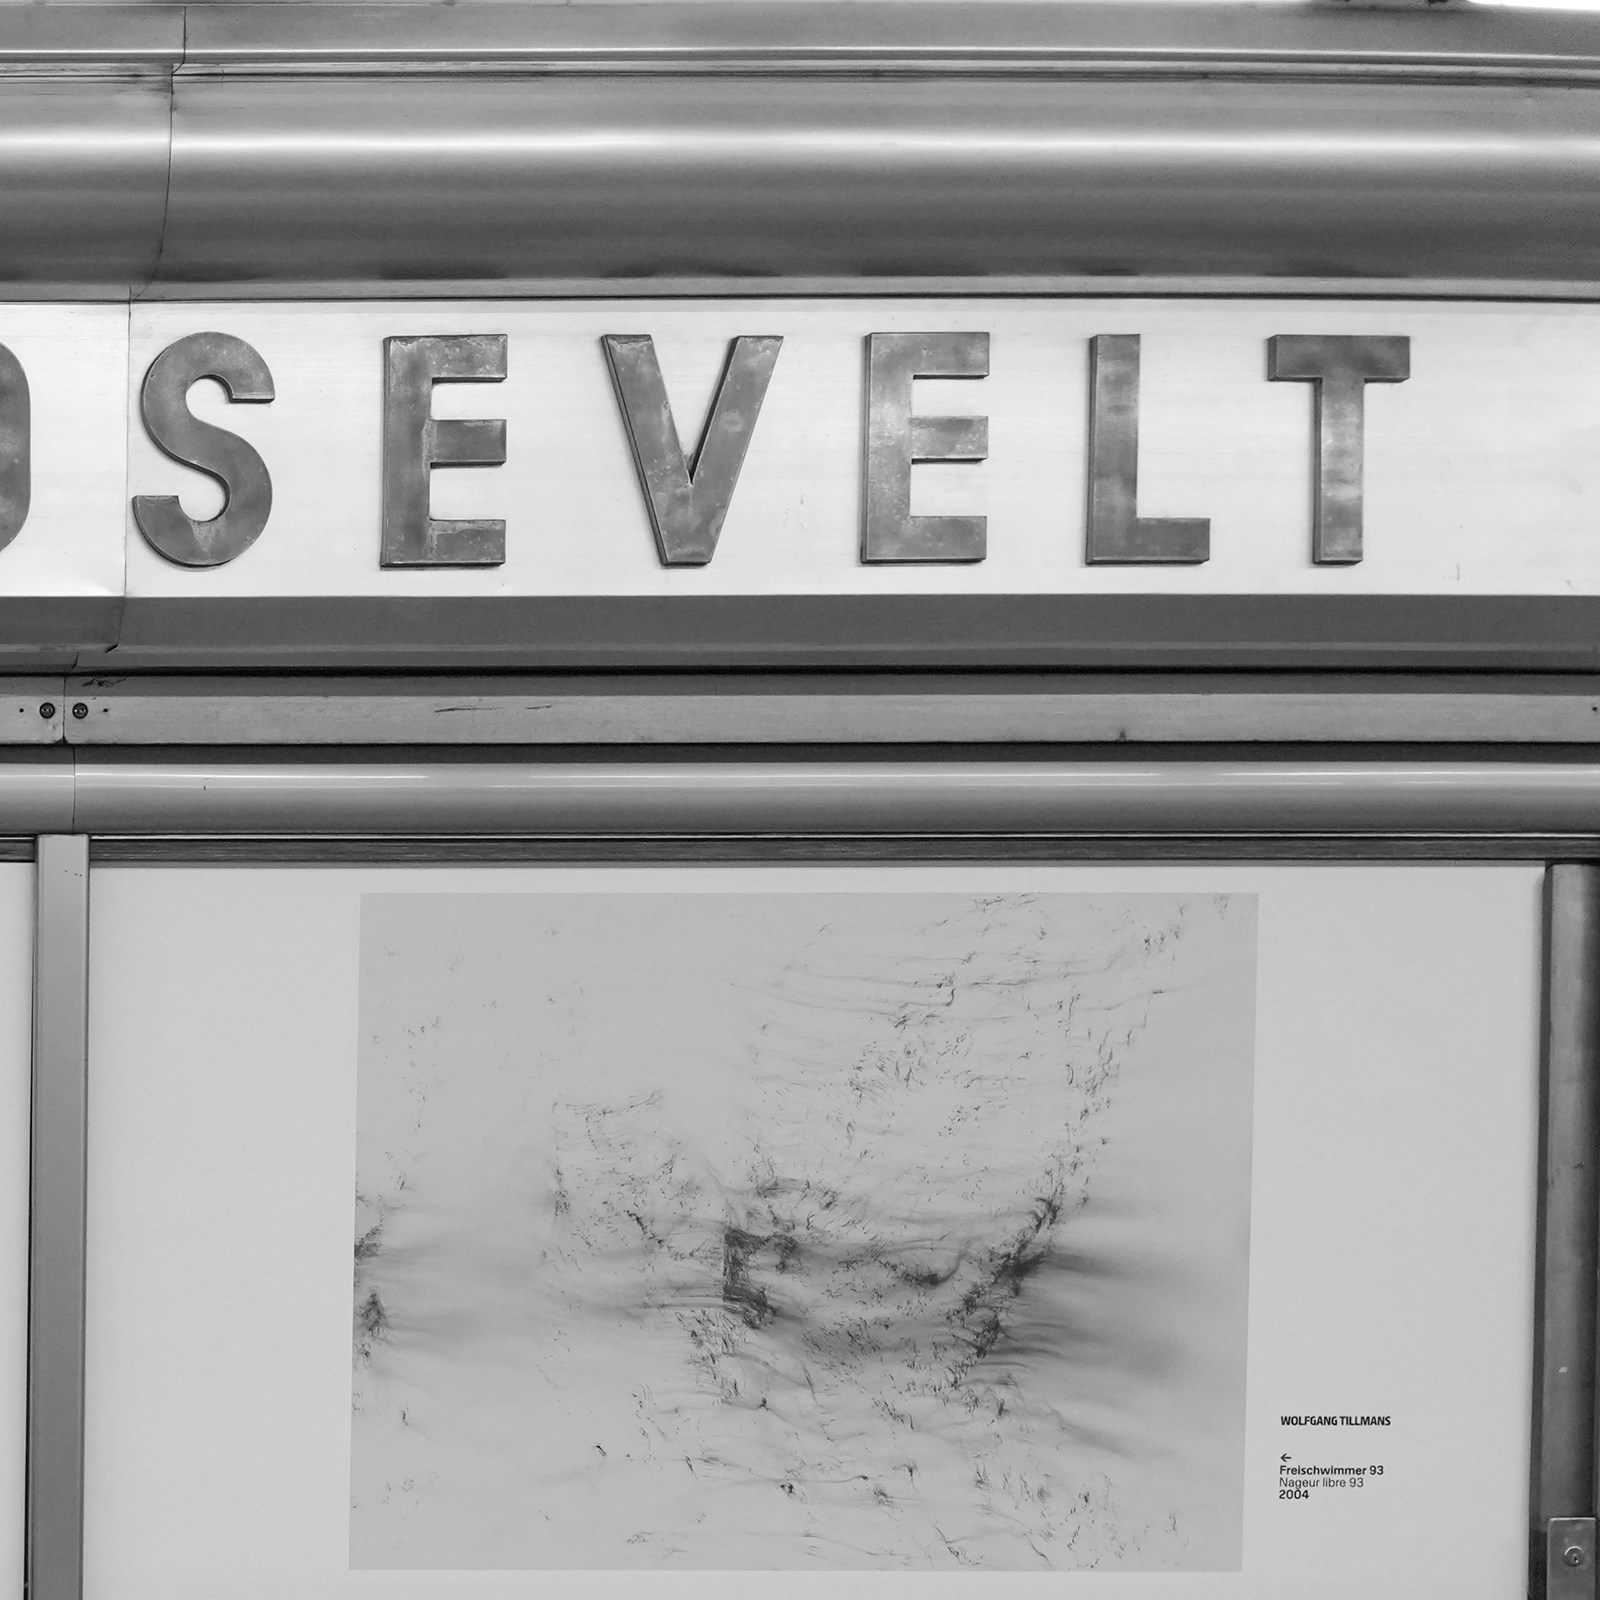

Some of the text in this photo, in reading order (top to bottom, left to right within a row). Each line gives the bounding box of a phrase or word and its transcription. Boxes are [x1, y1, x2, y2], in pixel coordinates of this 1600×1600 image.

[1281, 1416, 1390, 1425] WOLFGANG TILLMANS
[1280, 1465, 1383, 1475] Freischwimmer 93
[1280, 1477, 1363, 1489] Nageur libre 93
[1279, 1489, 1309, 1499] 2004
